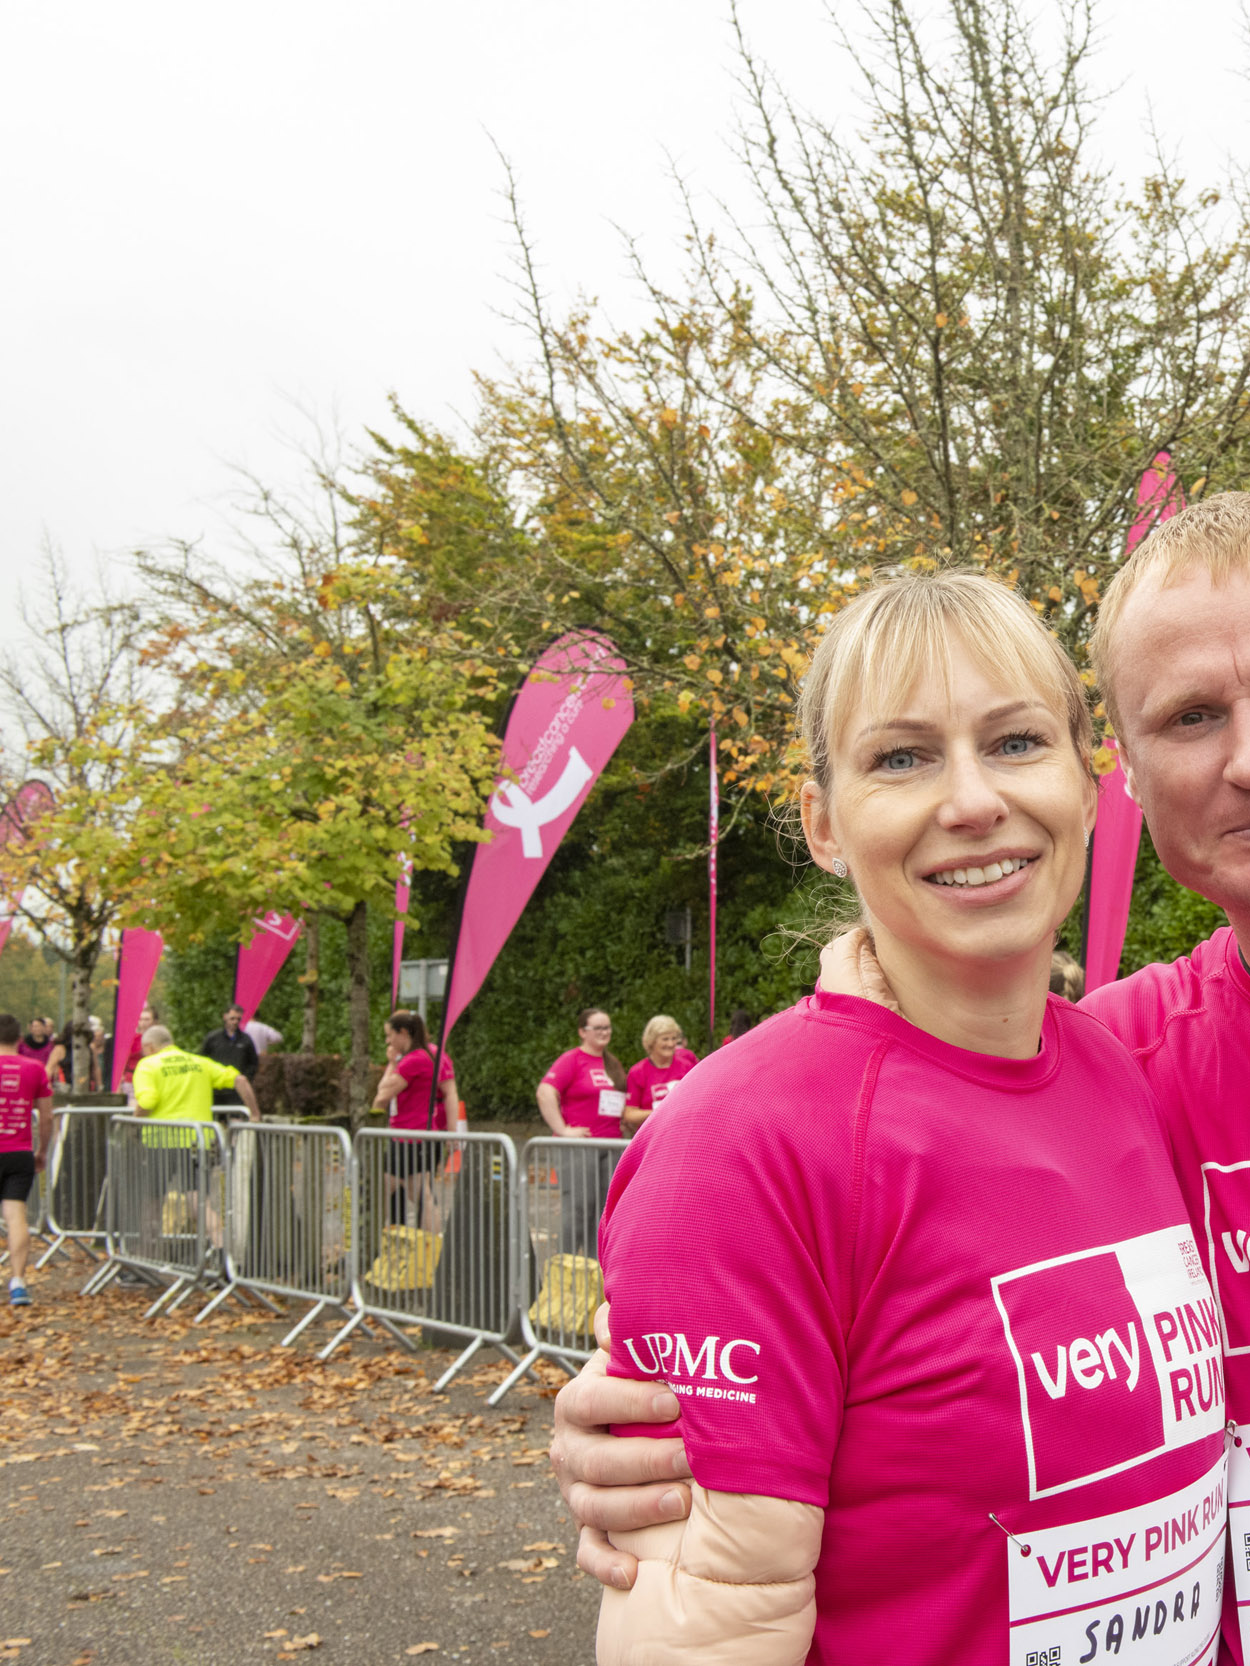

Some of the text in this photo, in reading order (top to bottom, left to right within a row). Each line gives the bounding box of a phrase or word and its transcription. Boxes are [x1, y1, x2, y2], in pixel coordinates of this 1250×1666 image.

[623, 1333, 760, 1384] UPMC
[1031, 1322, 1140, 1400] very
[1154, 1296, 1220, 1362] PINK
[696, 1386, 756, 1404] MEDICINE
[1170, 1354, 1224, 1422] RUN
[1036, 1477, 1224, 1588] VERY PINK RUN
[1080, 1582, 1200, 1664] SANDRA
